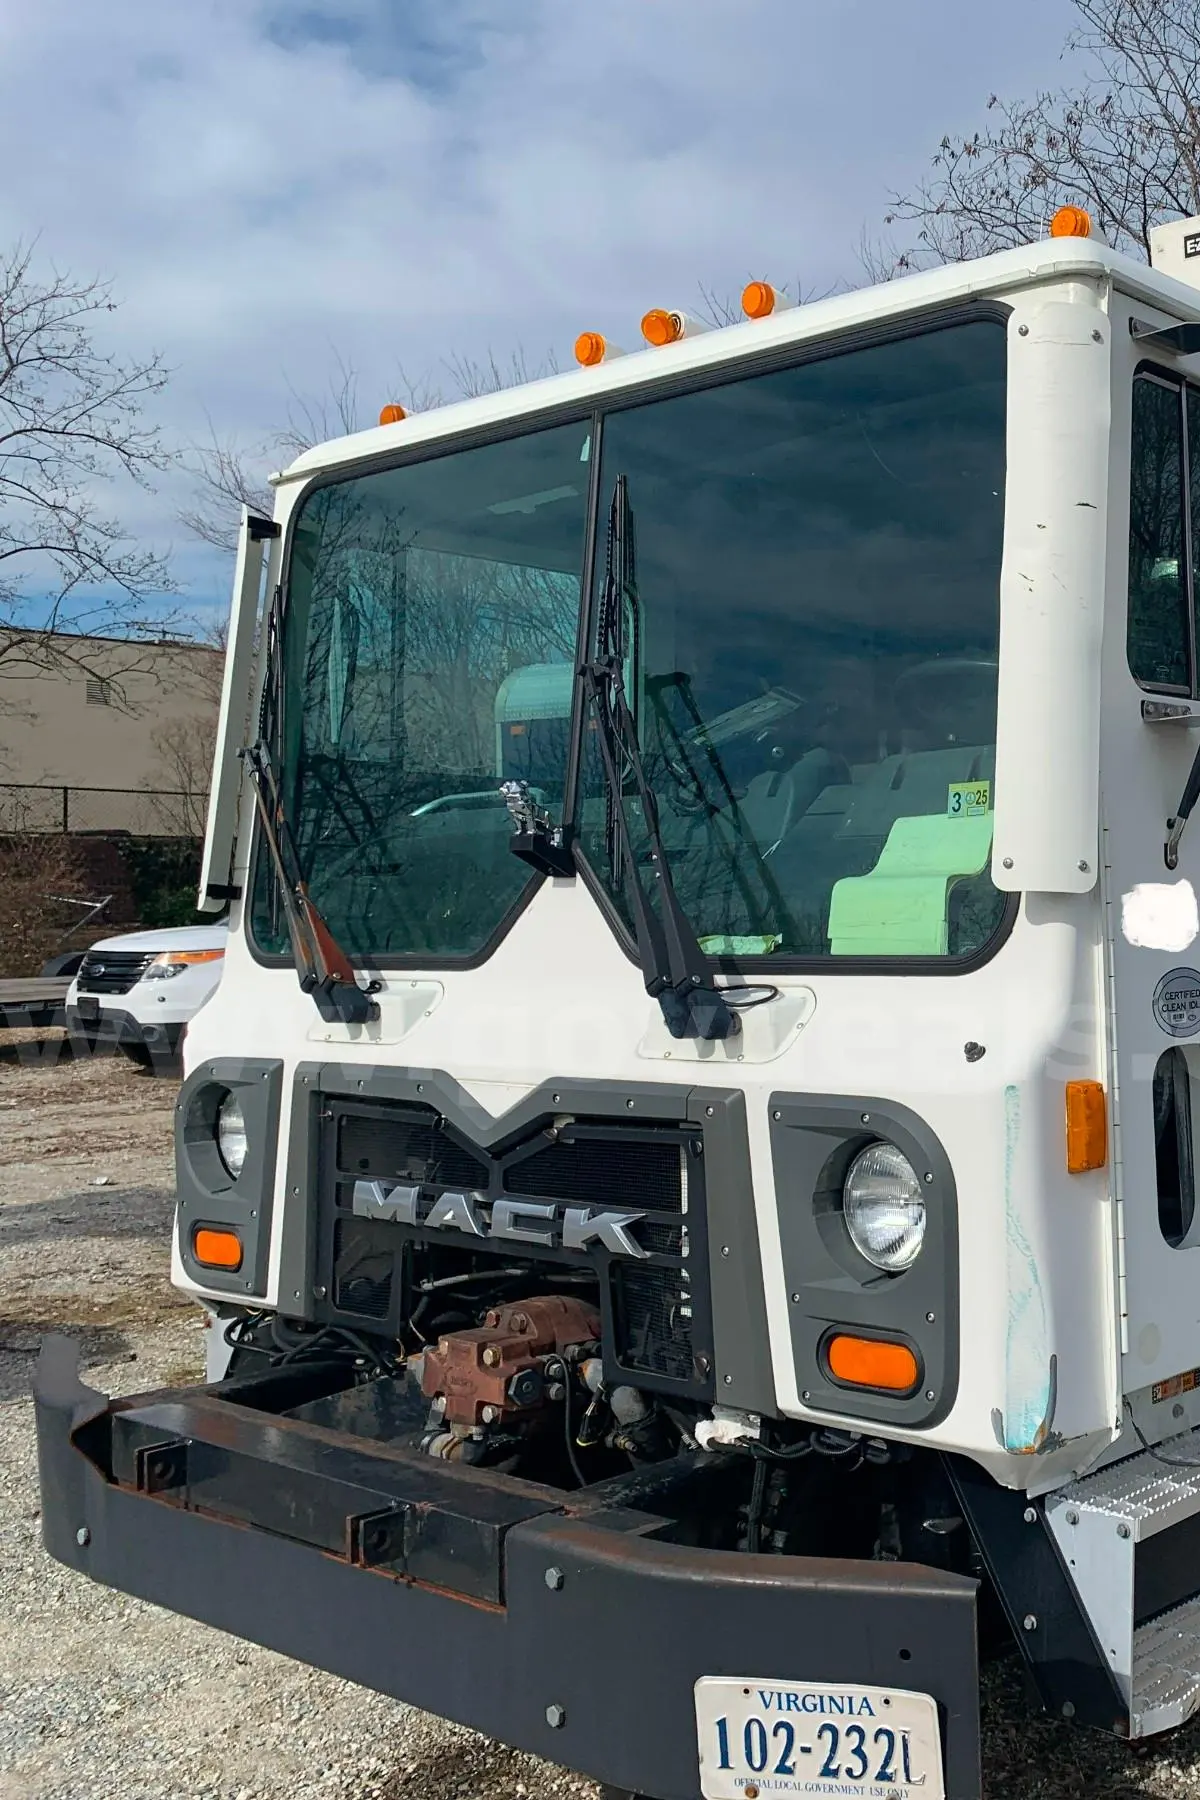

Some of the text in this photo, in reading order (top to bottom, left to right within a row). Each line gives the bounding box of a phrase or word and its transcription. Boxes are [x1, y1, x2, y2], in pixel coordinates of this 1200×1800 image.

[952, 791, 961, 813] 3
[975, 789, 988, 805] 25
[1165, 989, 1200, 1001] CERTIFIED
[1162, 1002, 1187, 1013] CLEAN
[352, 1179, 652, 1259] MACK
[757, 1690, 876, 1717] VIRGINIA
[775, 1781, 803, 1792] LOCAL
[804, 1783, 865, 1796] GOVERNMENT
[869, 1787, 887, 1797] USE
[887, 1788, 910, 1799] ONLY
